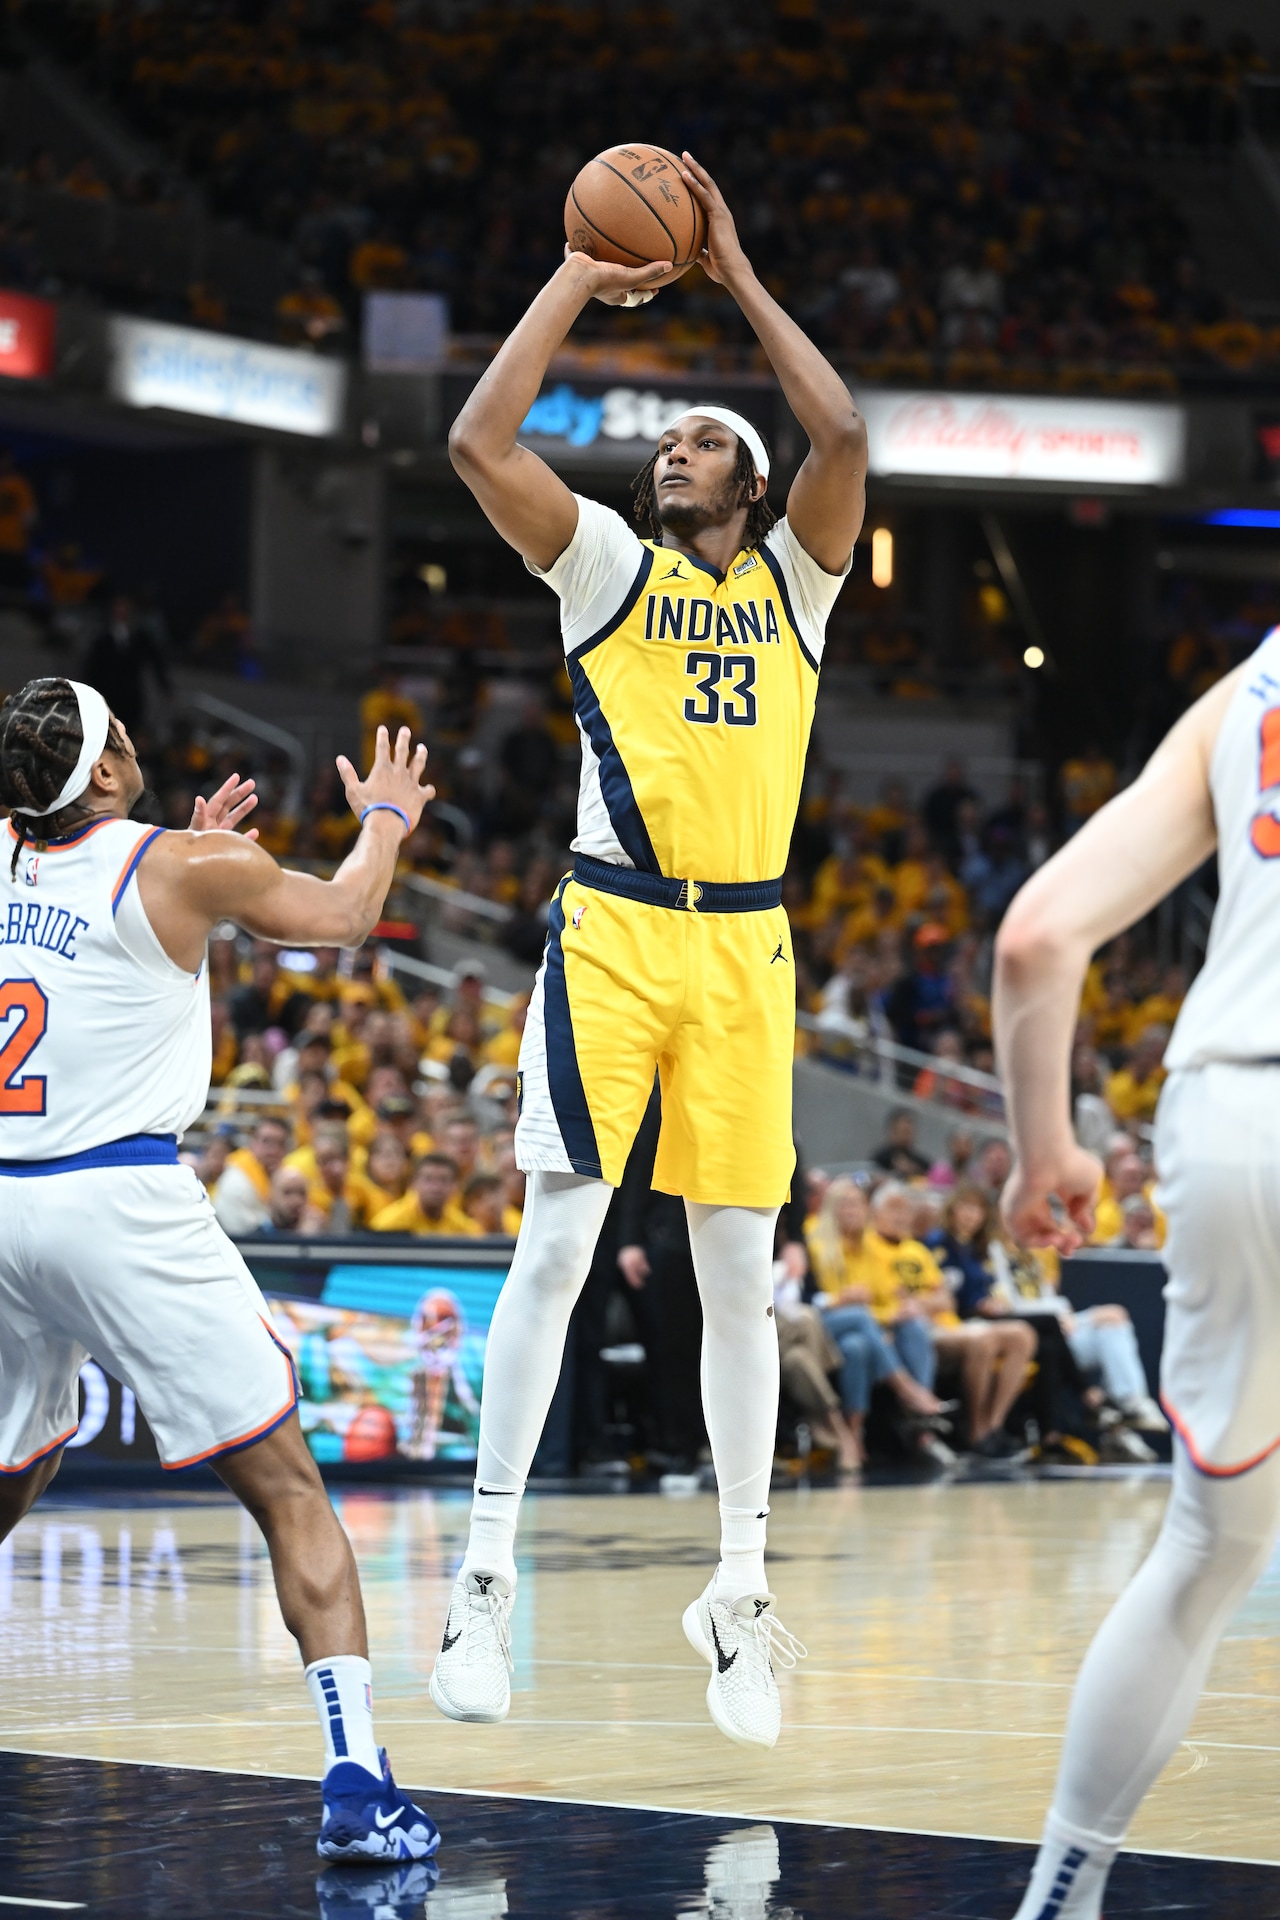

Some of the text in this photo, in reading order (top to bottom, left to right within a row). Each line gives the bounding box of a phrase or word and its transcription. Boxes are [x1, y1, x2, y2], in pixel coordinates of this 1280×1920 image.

[644, 594, 781, 647] INDANA
[683, 650, 757, 727] 33
[0, 978, 49, 1116] 2
